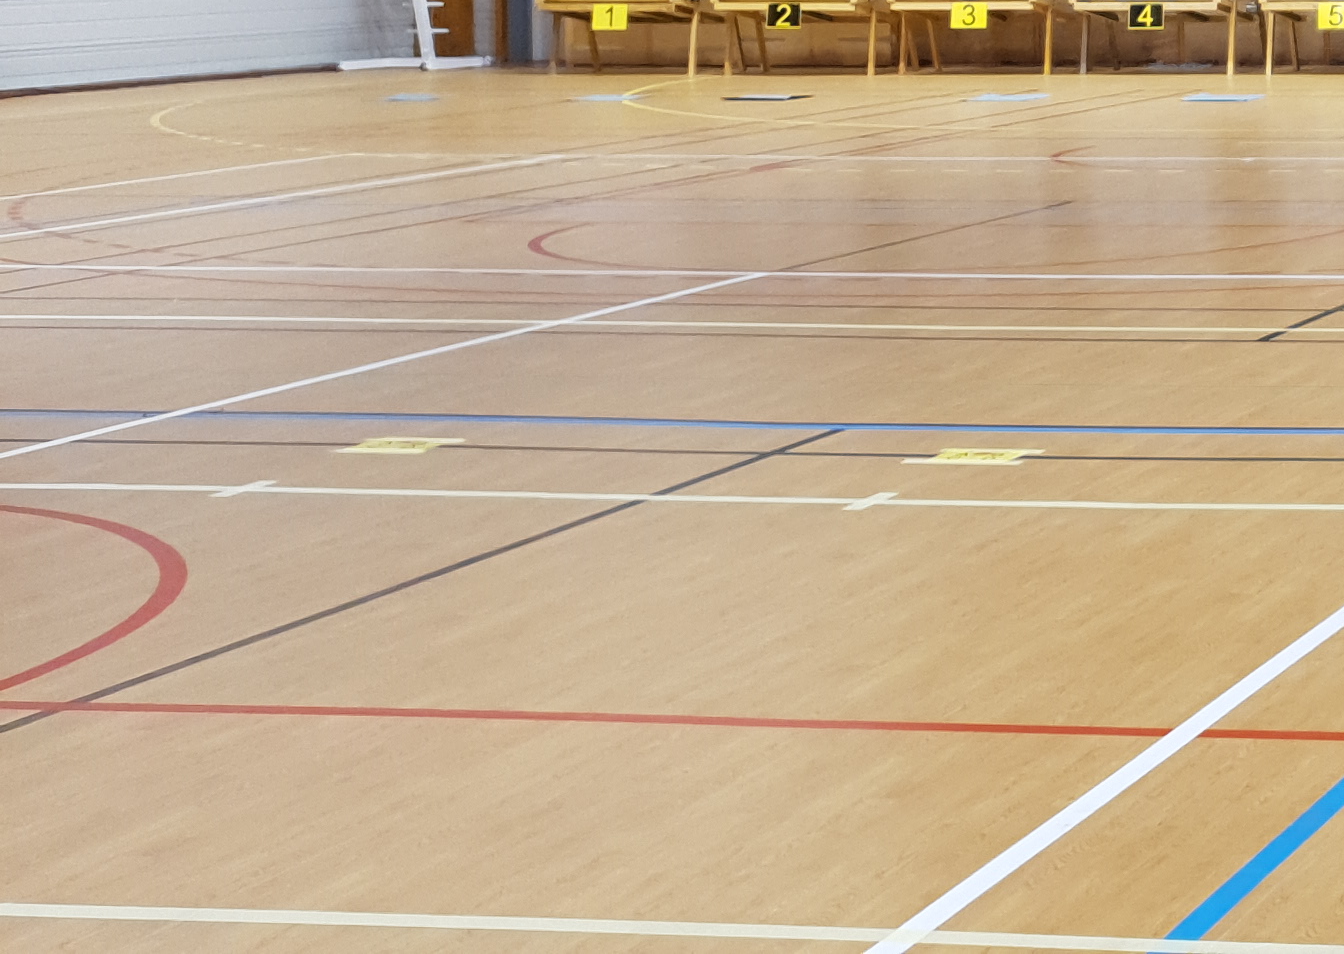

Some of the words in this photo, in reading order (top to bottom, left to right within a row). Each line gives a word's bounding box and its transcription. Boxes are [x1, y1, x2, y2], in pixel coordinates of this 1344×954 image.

[604, 6, 614, 27] 1
[776, 4, 791, 27] 2
[962, 5, 977, 26] 3
[1137, 4, 1154, 27] 4
[1329, 5, 1343, 26] 5
